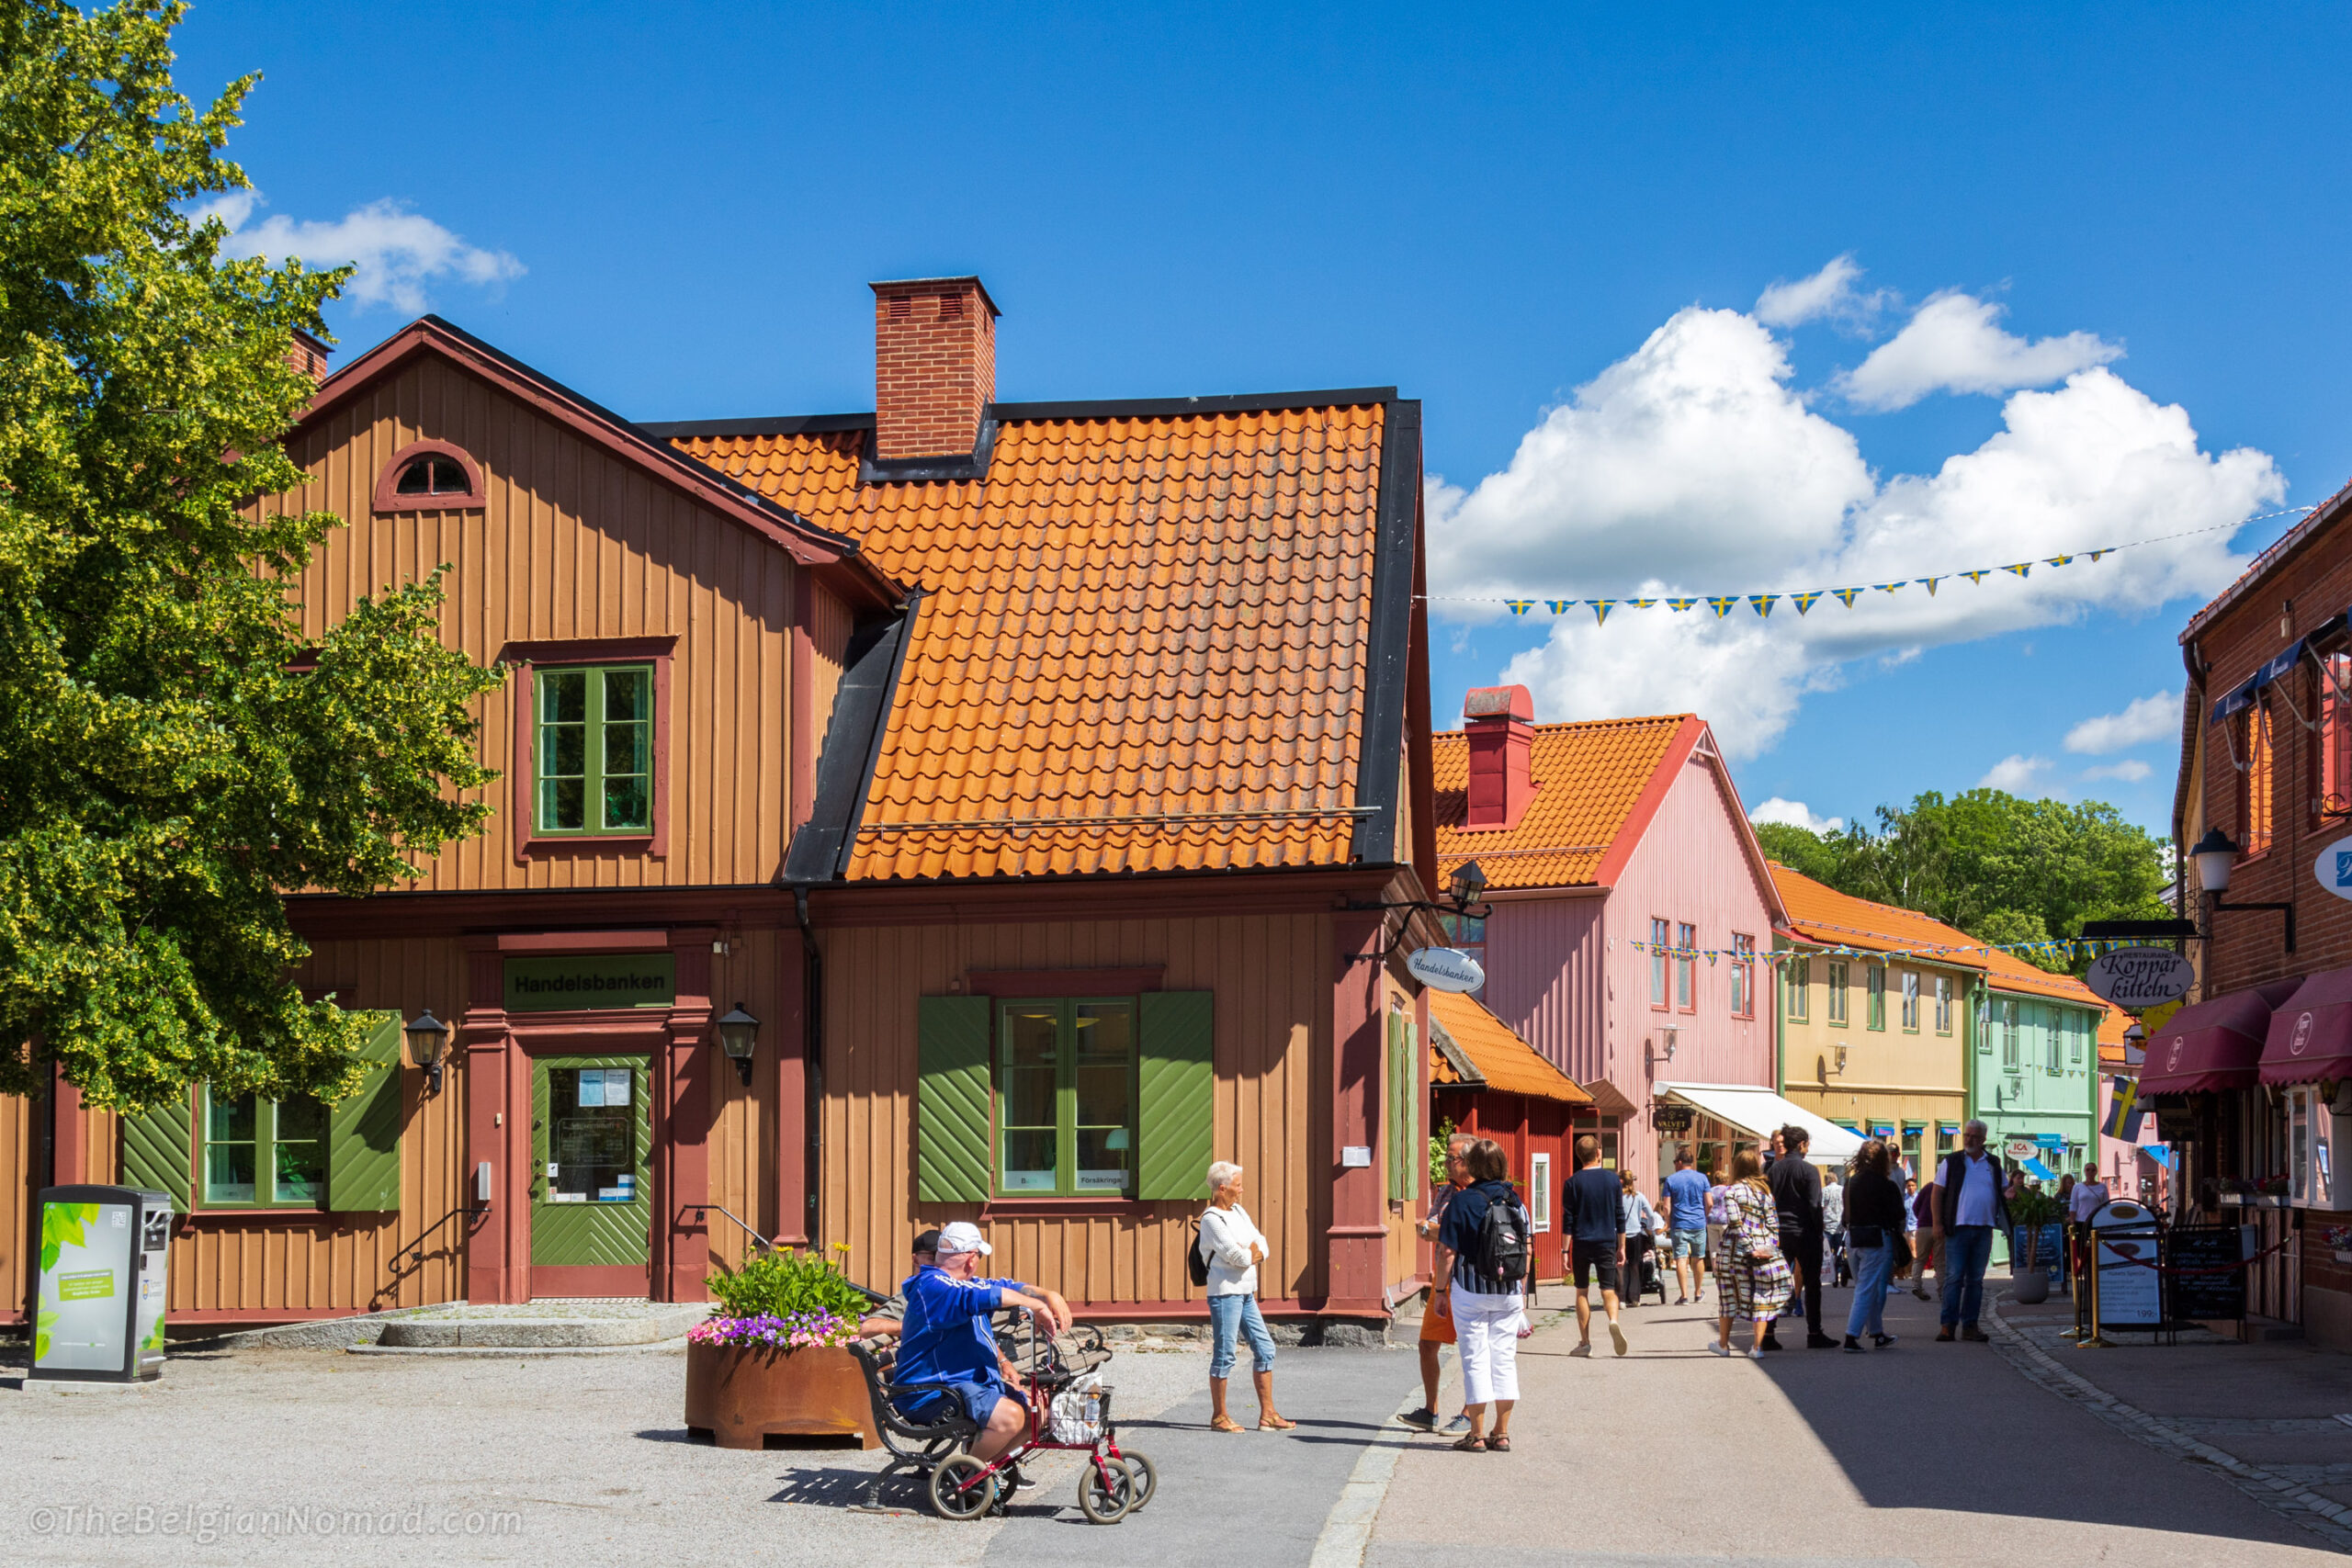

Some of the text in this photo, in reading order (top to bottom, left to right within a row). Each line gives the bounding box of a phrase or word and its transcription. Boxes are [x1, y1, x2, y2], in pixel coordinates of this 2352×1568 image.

[2123, 952, 2173, 960] RESTAURANG
[1413, 957, 1475, 984] Handelsbanken
[2100, 954, 2181, 985] Koppar
[514, 973, 665, 993] Handelsbanken
[2109, 974, 2183, 998] kitteln
[1657, 1120, 1687, 1128] VALVET
[2014, 1143, 2029, 1151] ICA
